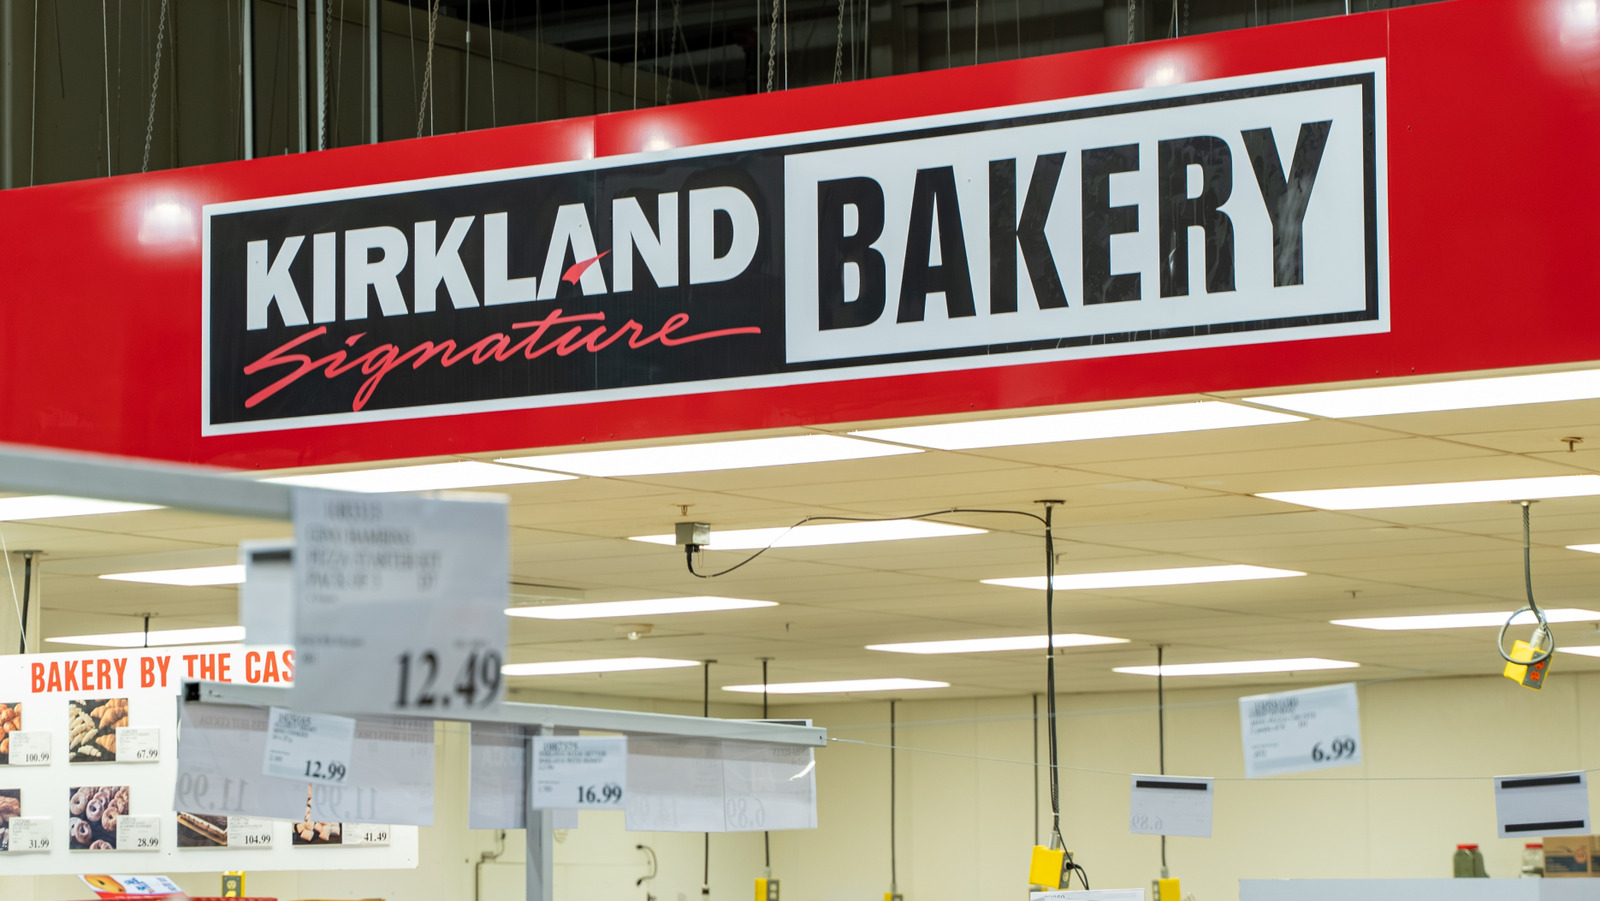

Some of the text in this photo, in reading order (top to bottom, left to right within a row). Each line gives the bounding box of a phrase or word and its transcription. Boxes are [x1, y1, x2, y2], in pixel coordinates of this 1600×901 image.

[817, 119, 1334, 331] BAKERY
[246, 186, 760, 331] KIRKLAND
[244, 312, 761, 412] Signature
[31, 650, 296, 693] BAKERY BY THE CAS
[392, 648, 503, 711] 12.49
[25, 753, 50, 763] 100.99
[136, 749, 158, 759] 67.99
[1311, 737, 1357, 763] 6.99
[303, 760, 347, 782] 12.99
[577, 784, 623, 804] 16.99
[28, 838, 50, 849] 31.99
[137, 837, 159, 847] 28.99
[244, 834, 271, 845] 104.99
[363, 831, 388, 842] 41.49
